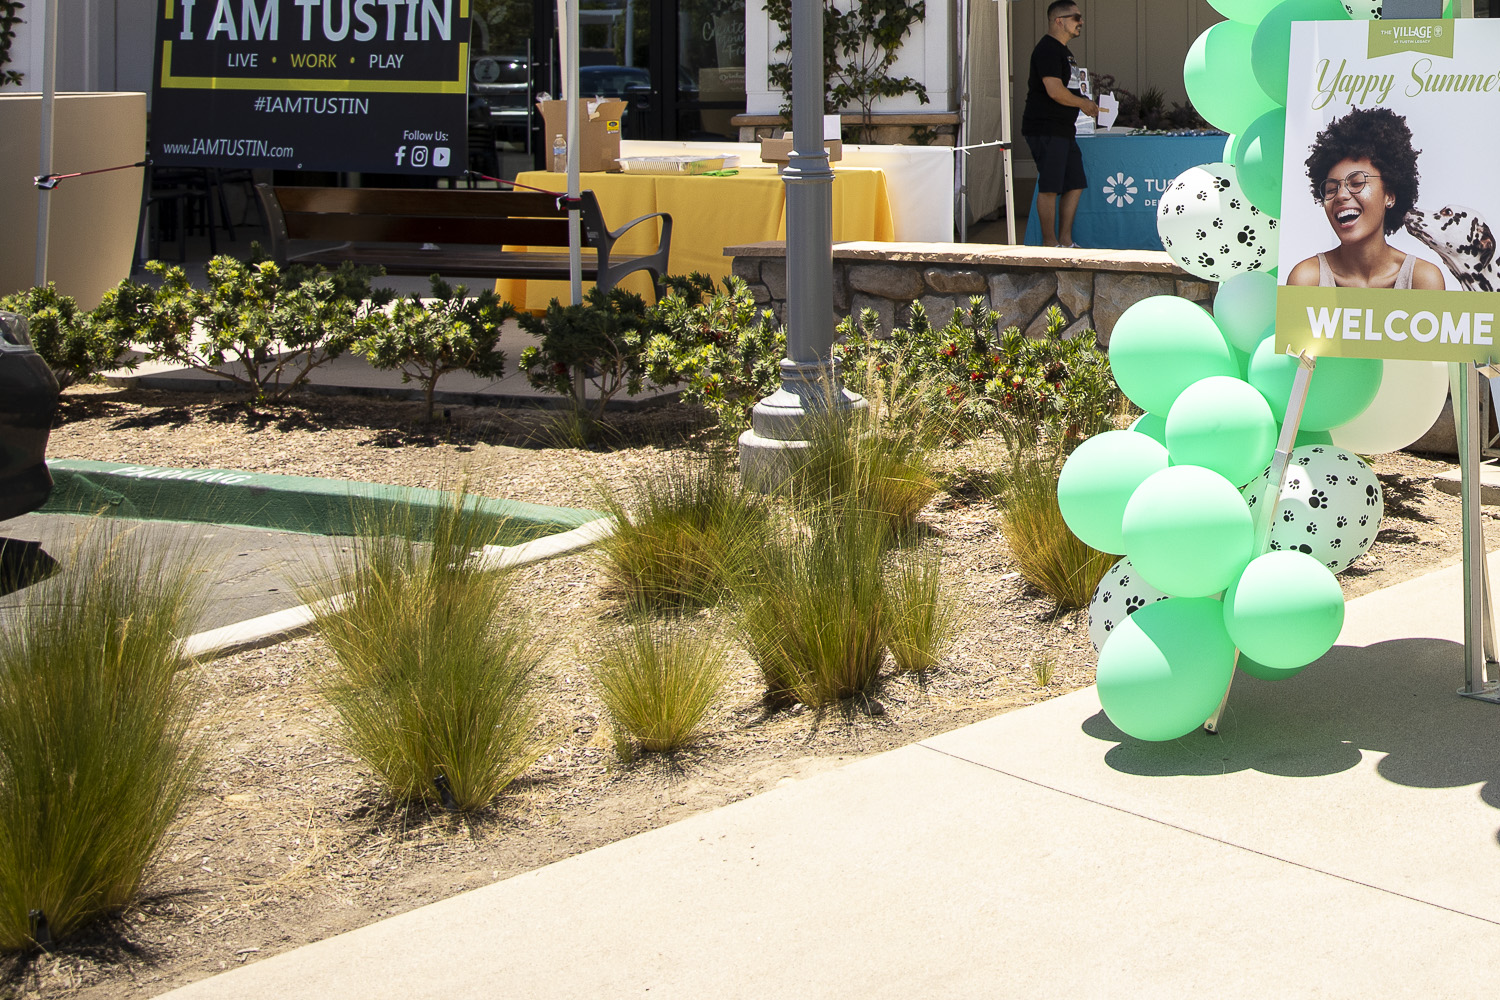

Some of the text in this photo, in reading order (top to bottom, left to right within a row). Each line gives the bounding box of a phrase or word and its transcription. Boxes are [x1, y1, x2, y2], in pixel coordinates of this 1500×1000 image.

[1392, 25, 1432, 39] VILLAGE
[227, 53, 405, 69] LIVE WORK PLAY
[1311, 58, 1396, 111] Yappy
[253, 96, 369, 115] #IAMTUSTIN
[403, 130, 449, 142] Follow Us:
[163, 138, 294, 158] www.IAMTUSTIN.com
[1305, 306, 1495, 346] WELCOME
